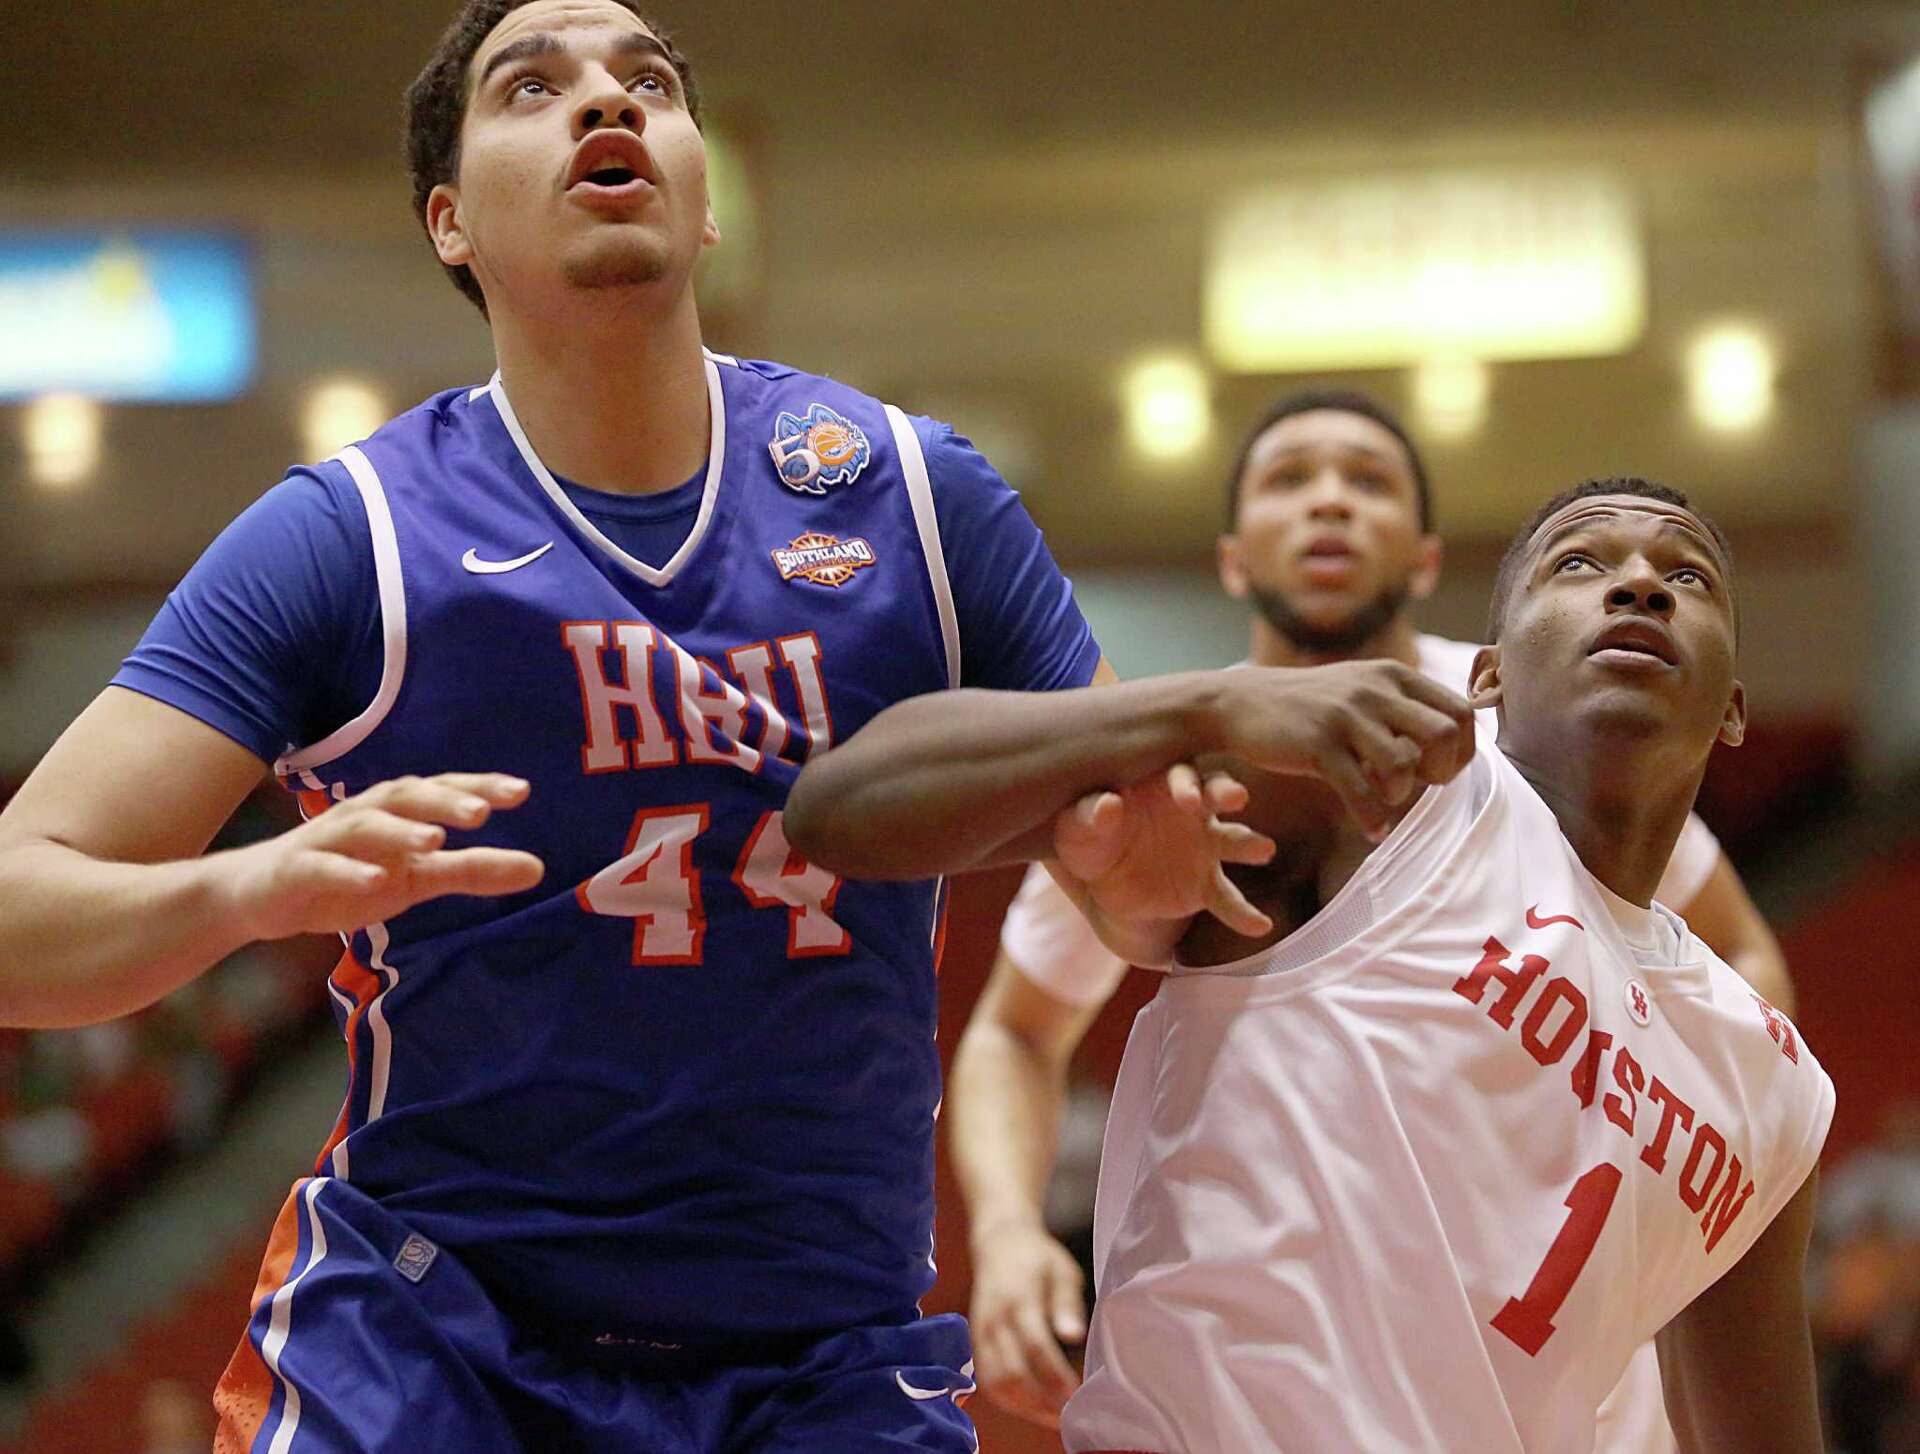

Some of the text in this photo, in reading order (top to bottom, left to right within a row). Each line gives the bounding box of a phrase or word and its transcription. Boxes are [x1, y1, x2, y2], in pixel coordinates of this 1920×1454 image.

[776, 540, 872, 574] SOUTHLAND
[560, 620, 836, 776] HBU
[575, 803, 853, 966] 44
[1452, 936, 1755, 1255] HOUSTON
[1490, 1162, 1623, 1357] 1
